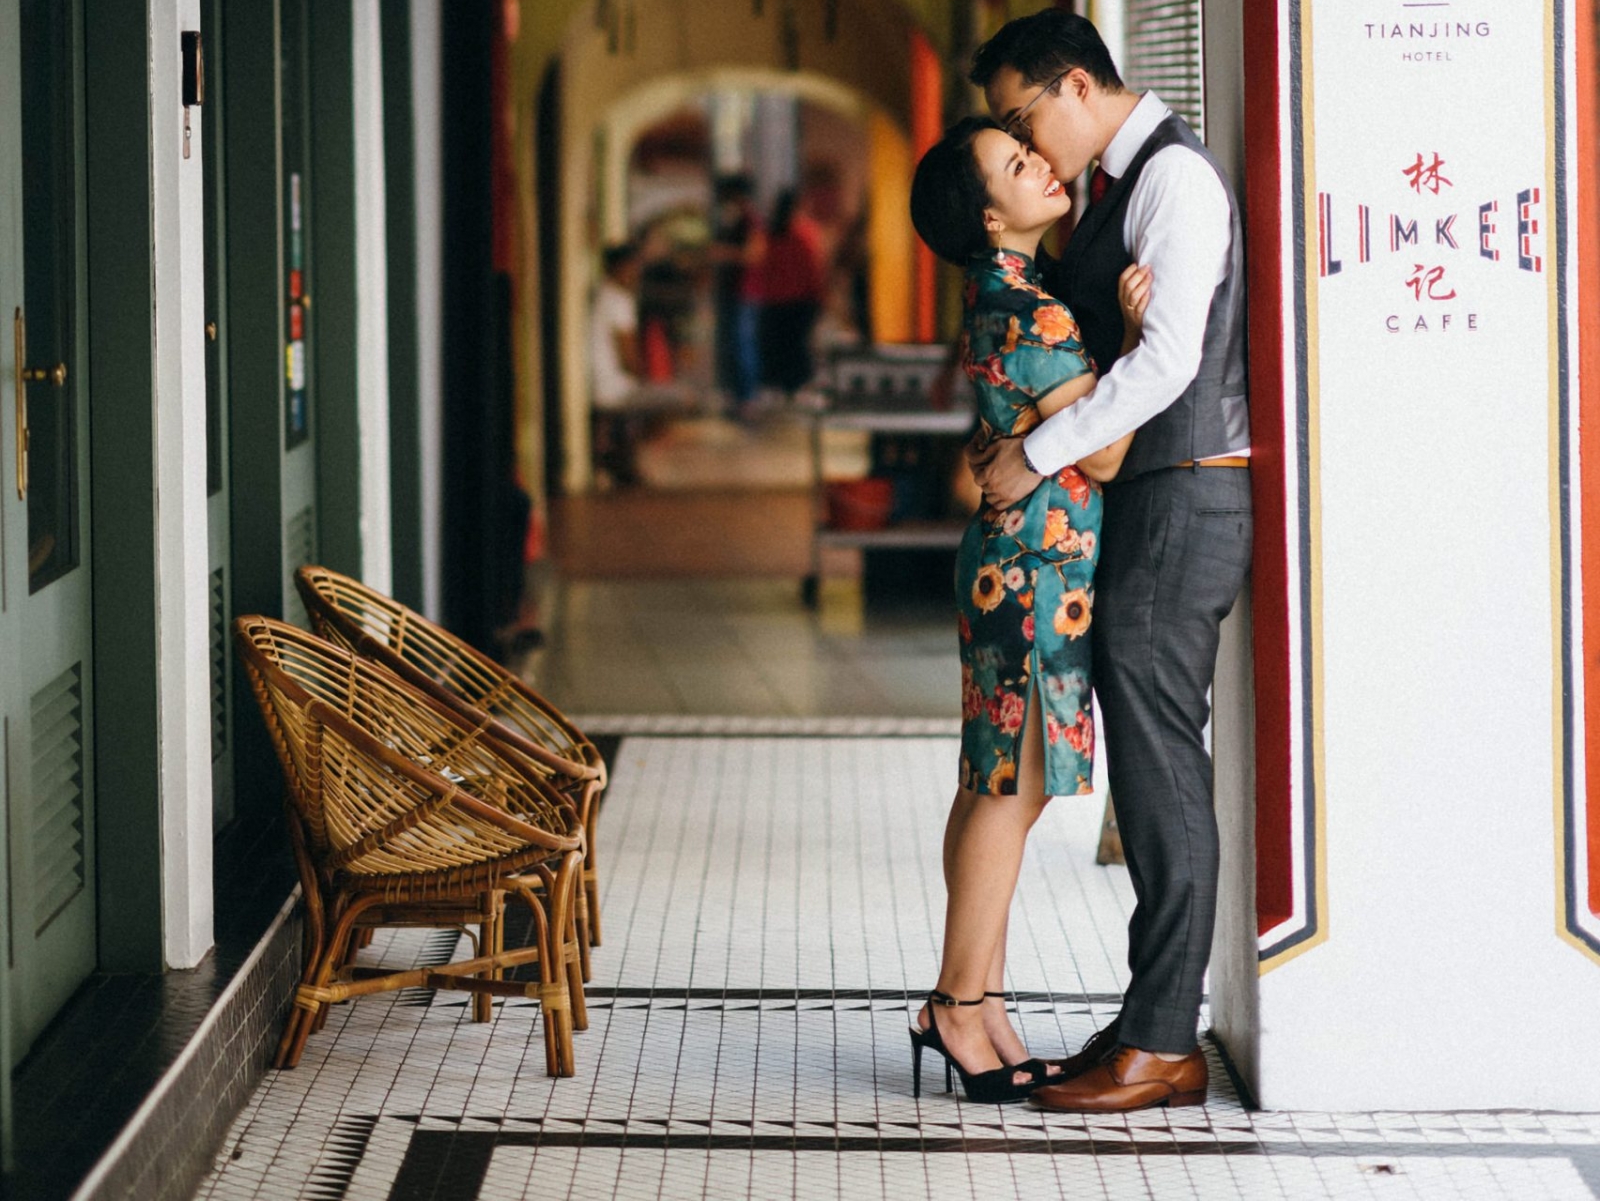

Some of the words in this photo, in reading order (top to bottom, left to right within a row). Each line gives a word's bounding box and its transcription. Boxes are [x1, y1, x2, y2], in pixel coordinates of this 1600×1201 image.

[1365, 22, 1489, 38] TIANJING
[1403, 51, 1452, 62] HOTEL
[1402, 152, 1453, 195] 林
[1405, 264, 1457, 301] 记
[1386, 314, 1477, 333] CAFE
